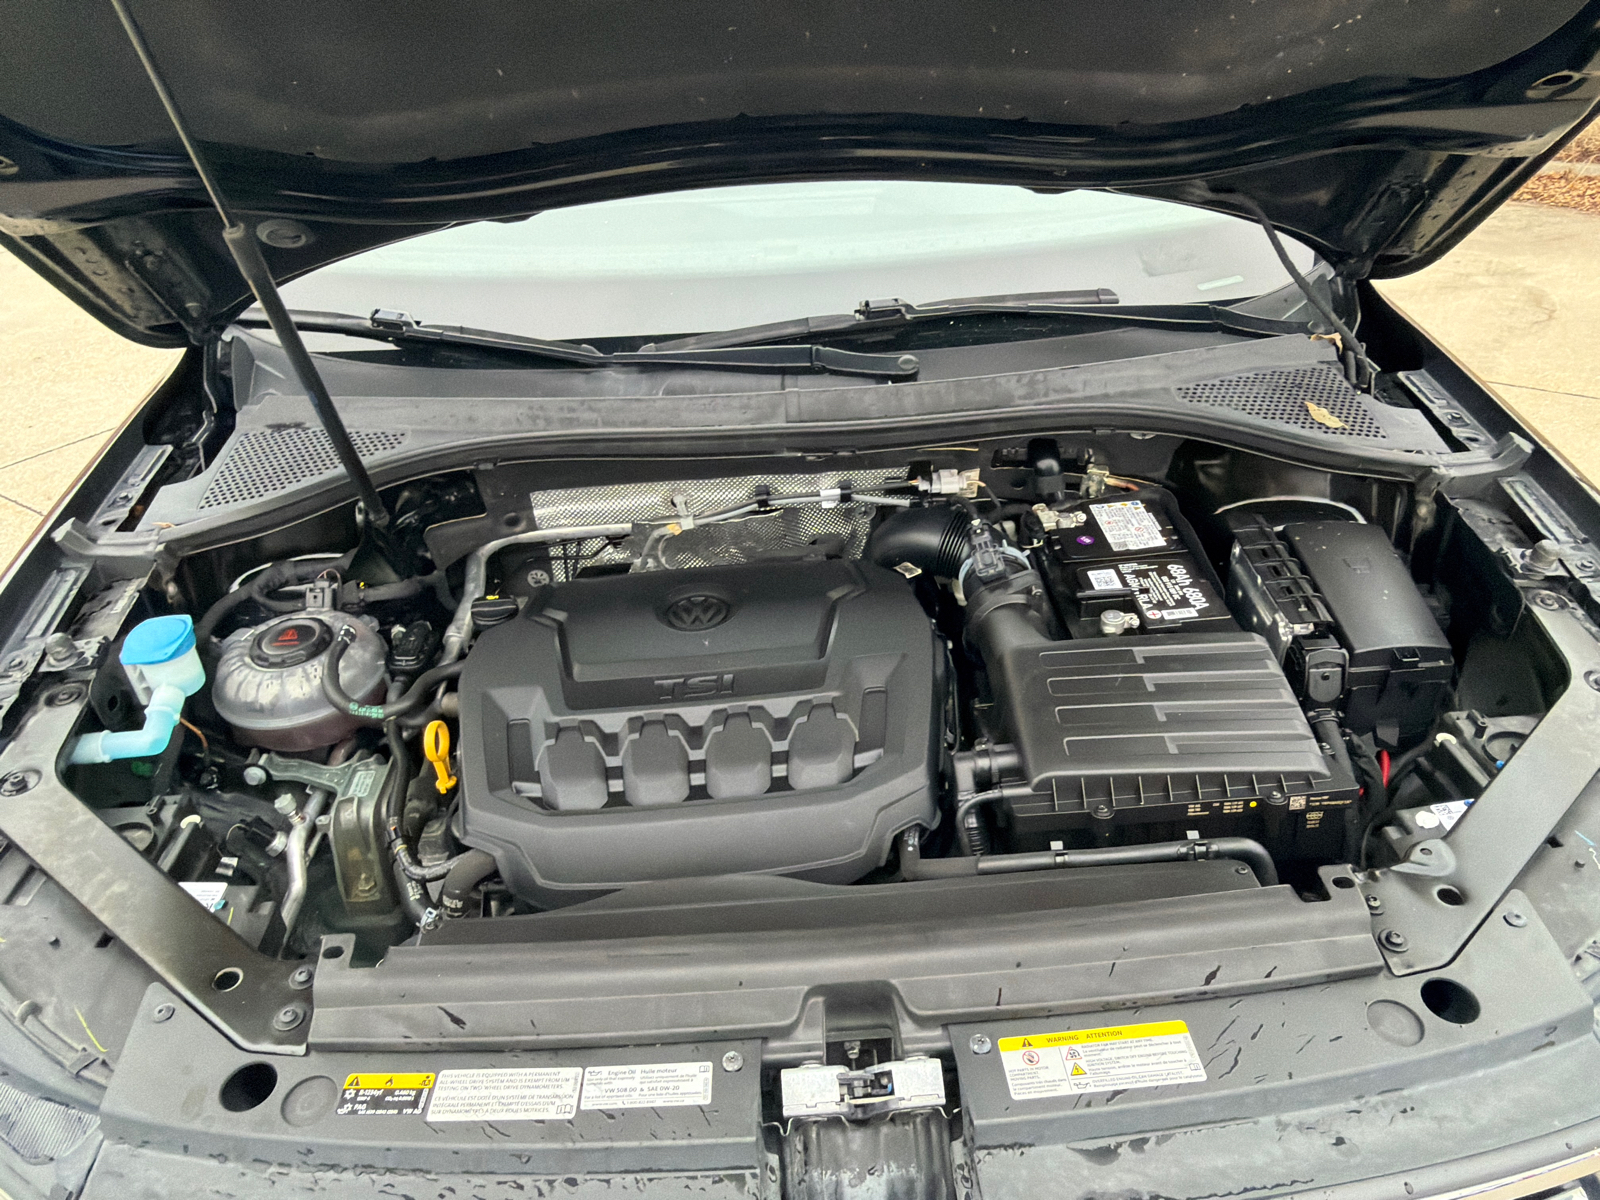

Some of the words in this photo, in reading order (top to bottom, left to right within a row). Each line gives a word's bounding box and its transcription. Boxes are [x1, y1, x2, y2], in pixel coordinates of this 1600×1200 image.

[1167, 564, 1193, 586] 68Ah
[1182, 587, 1210, 611] 680A
[654, 674, 734, 699] TSI
[1046, 1034, 1079, 1043] WARNING
[1086, 1030, 1123, 1039] ATTENTION
